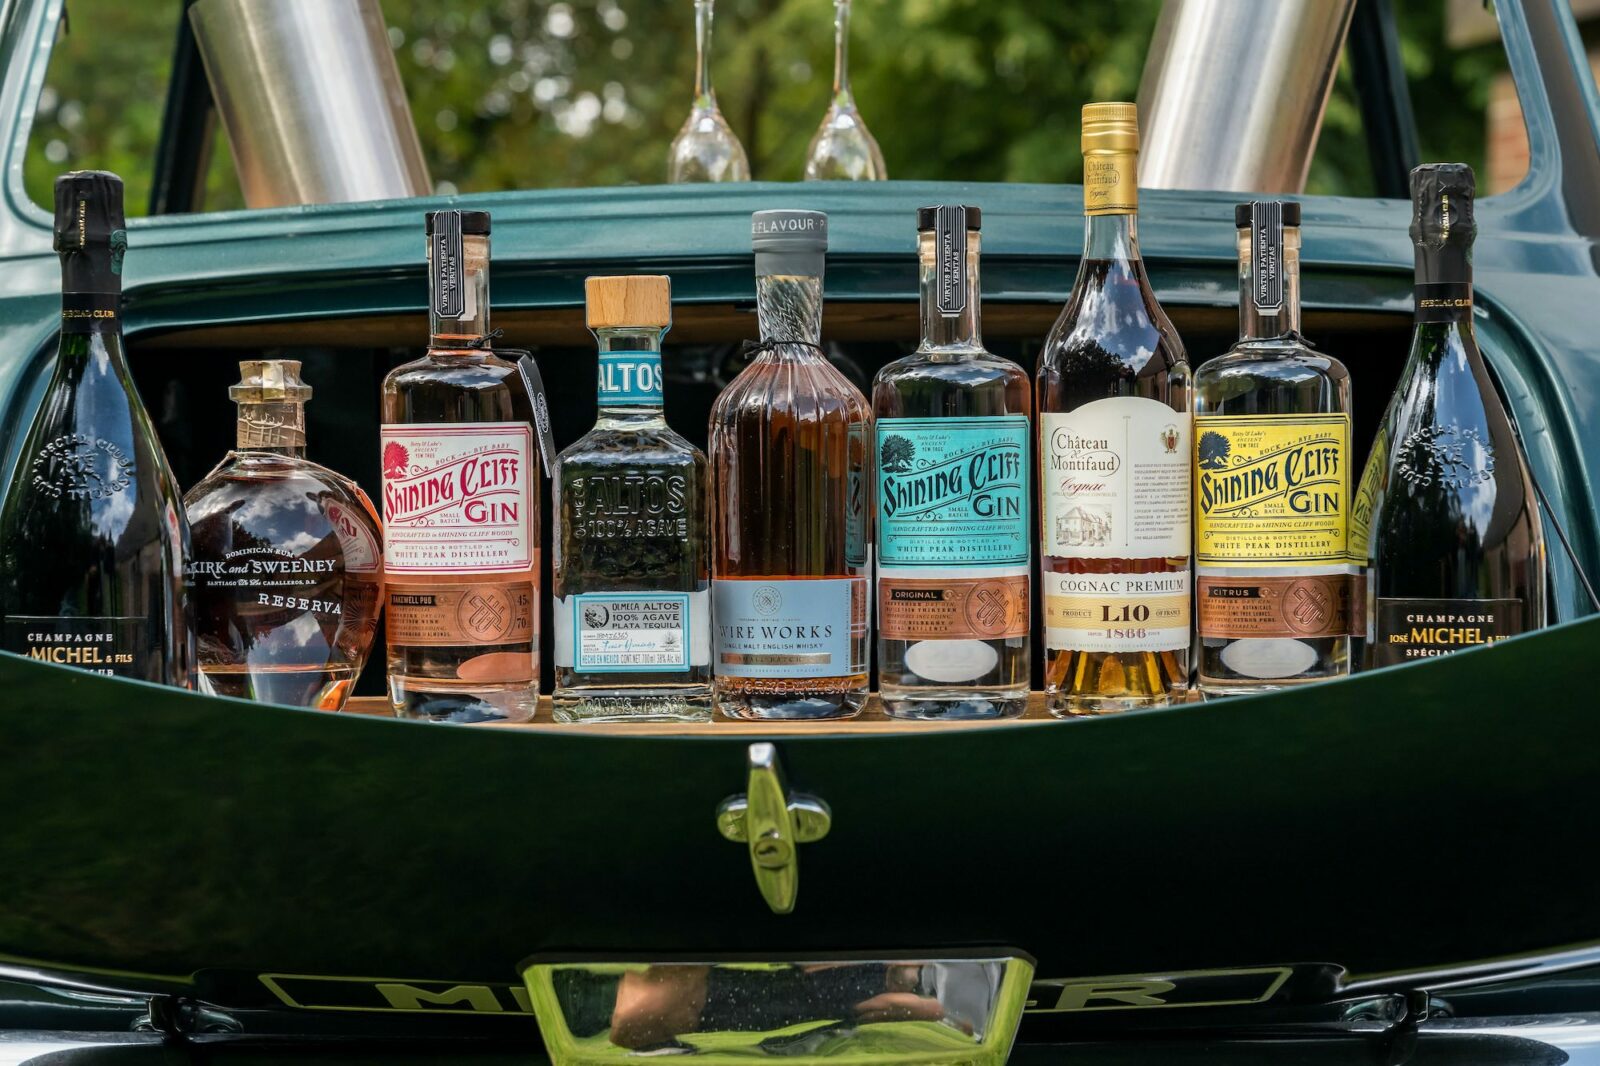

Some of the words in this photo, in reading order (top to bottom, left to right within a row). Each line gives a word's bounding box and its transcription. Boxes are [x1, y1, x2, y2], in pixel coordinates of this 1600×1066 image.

[758, 219, 814, 233] FLAVOUR
[448, 256, 456, 291] VERITAS
[93, 310, 115, 318] CLUB
[598, 362, 663, 393] ALTOS
[1057, 434, 1108, 450] Château
[1260, 444, 1280, 455] ROCK
[436, 455, 456, 465] ROCK
[1051, 455, 1115, 471] Montifaud
[1061, 477, 1106, 497] Cognac
[587, 475, 686, 515] ALTOS
[1289, 490, 1339, 514] GIN
[464, 500, 519, 523] GIN
[973, 495, 1020, 517] GIN
[225, 547, 273, 560] DOMINICAN
[275, 549, 295, 558] RUM
[451, 550, 509, 558] DISTILLERY
[228, 563, 249, 574] and
[249, 557, 336, 574] SWEENEY
[1060, 580, 1120, 592] COGNAC
[1126, 579, 1184, 592] PREMIUM
[895, 591, 937, 599] ORIGINAL
[258, 593, 342, 615] RESERVA
[612, 603, 640, 611] OLMECA
[1406, 614, 1494, 623] CHAMPAGNE
[27, 633, 114, 642] CHAMPAGNE
[719, 626, 754, 639] WIRE
[761, 625, 832, 639] WORKS
[1106, 628, 1147, 639] 1866
[1389, 633, 1409, 643] JOSÉ
[1410, 627, 1485, 644] MICHEL
[31, 646, 103, 663] MICHEL
[105, 655, 112, 663] &
[115, 654, 133, 663] FILS
